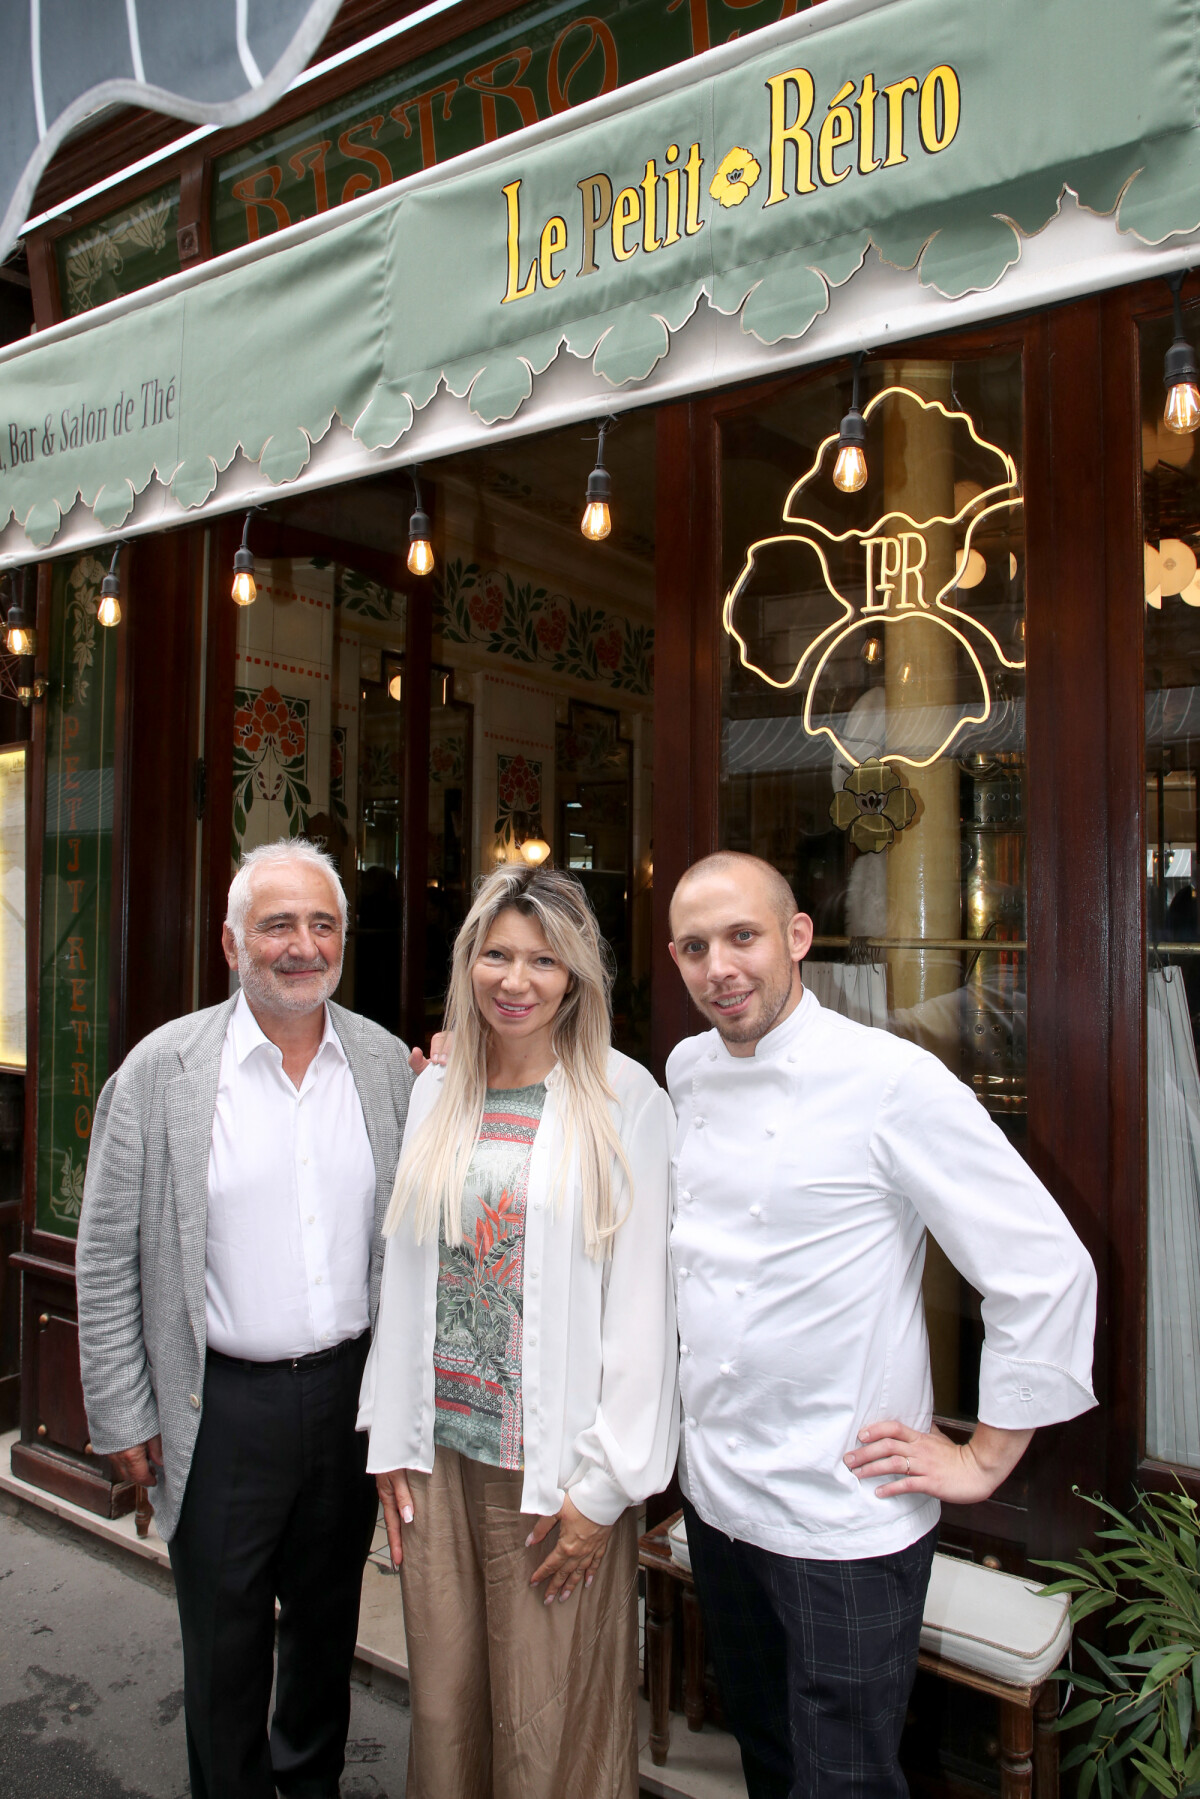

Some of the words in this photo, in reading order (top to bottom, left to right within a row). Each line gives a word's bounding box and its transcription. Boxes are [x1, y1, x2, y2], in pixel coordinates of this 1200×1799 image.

[232, 16, 619, 242] BISTRO
[500, 178, 568, 304] Le
[575, 143, 705, 277] Petit
[762, 63, 961, 209] Rétro
[8, 422, 37, 468] Bar
[41, 413, 55, 457] &
[59, 403, 107, 452] Salon
[113, 390, 134, 437] de
[140, 375, 176, 430] Thé
[67, 937, 91, 1139] RETRO
[1019, 1386, 1034, 1402] B
